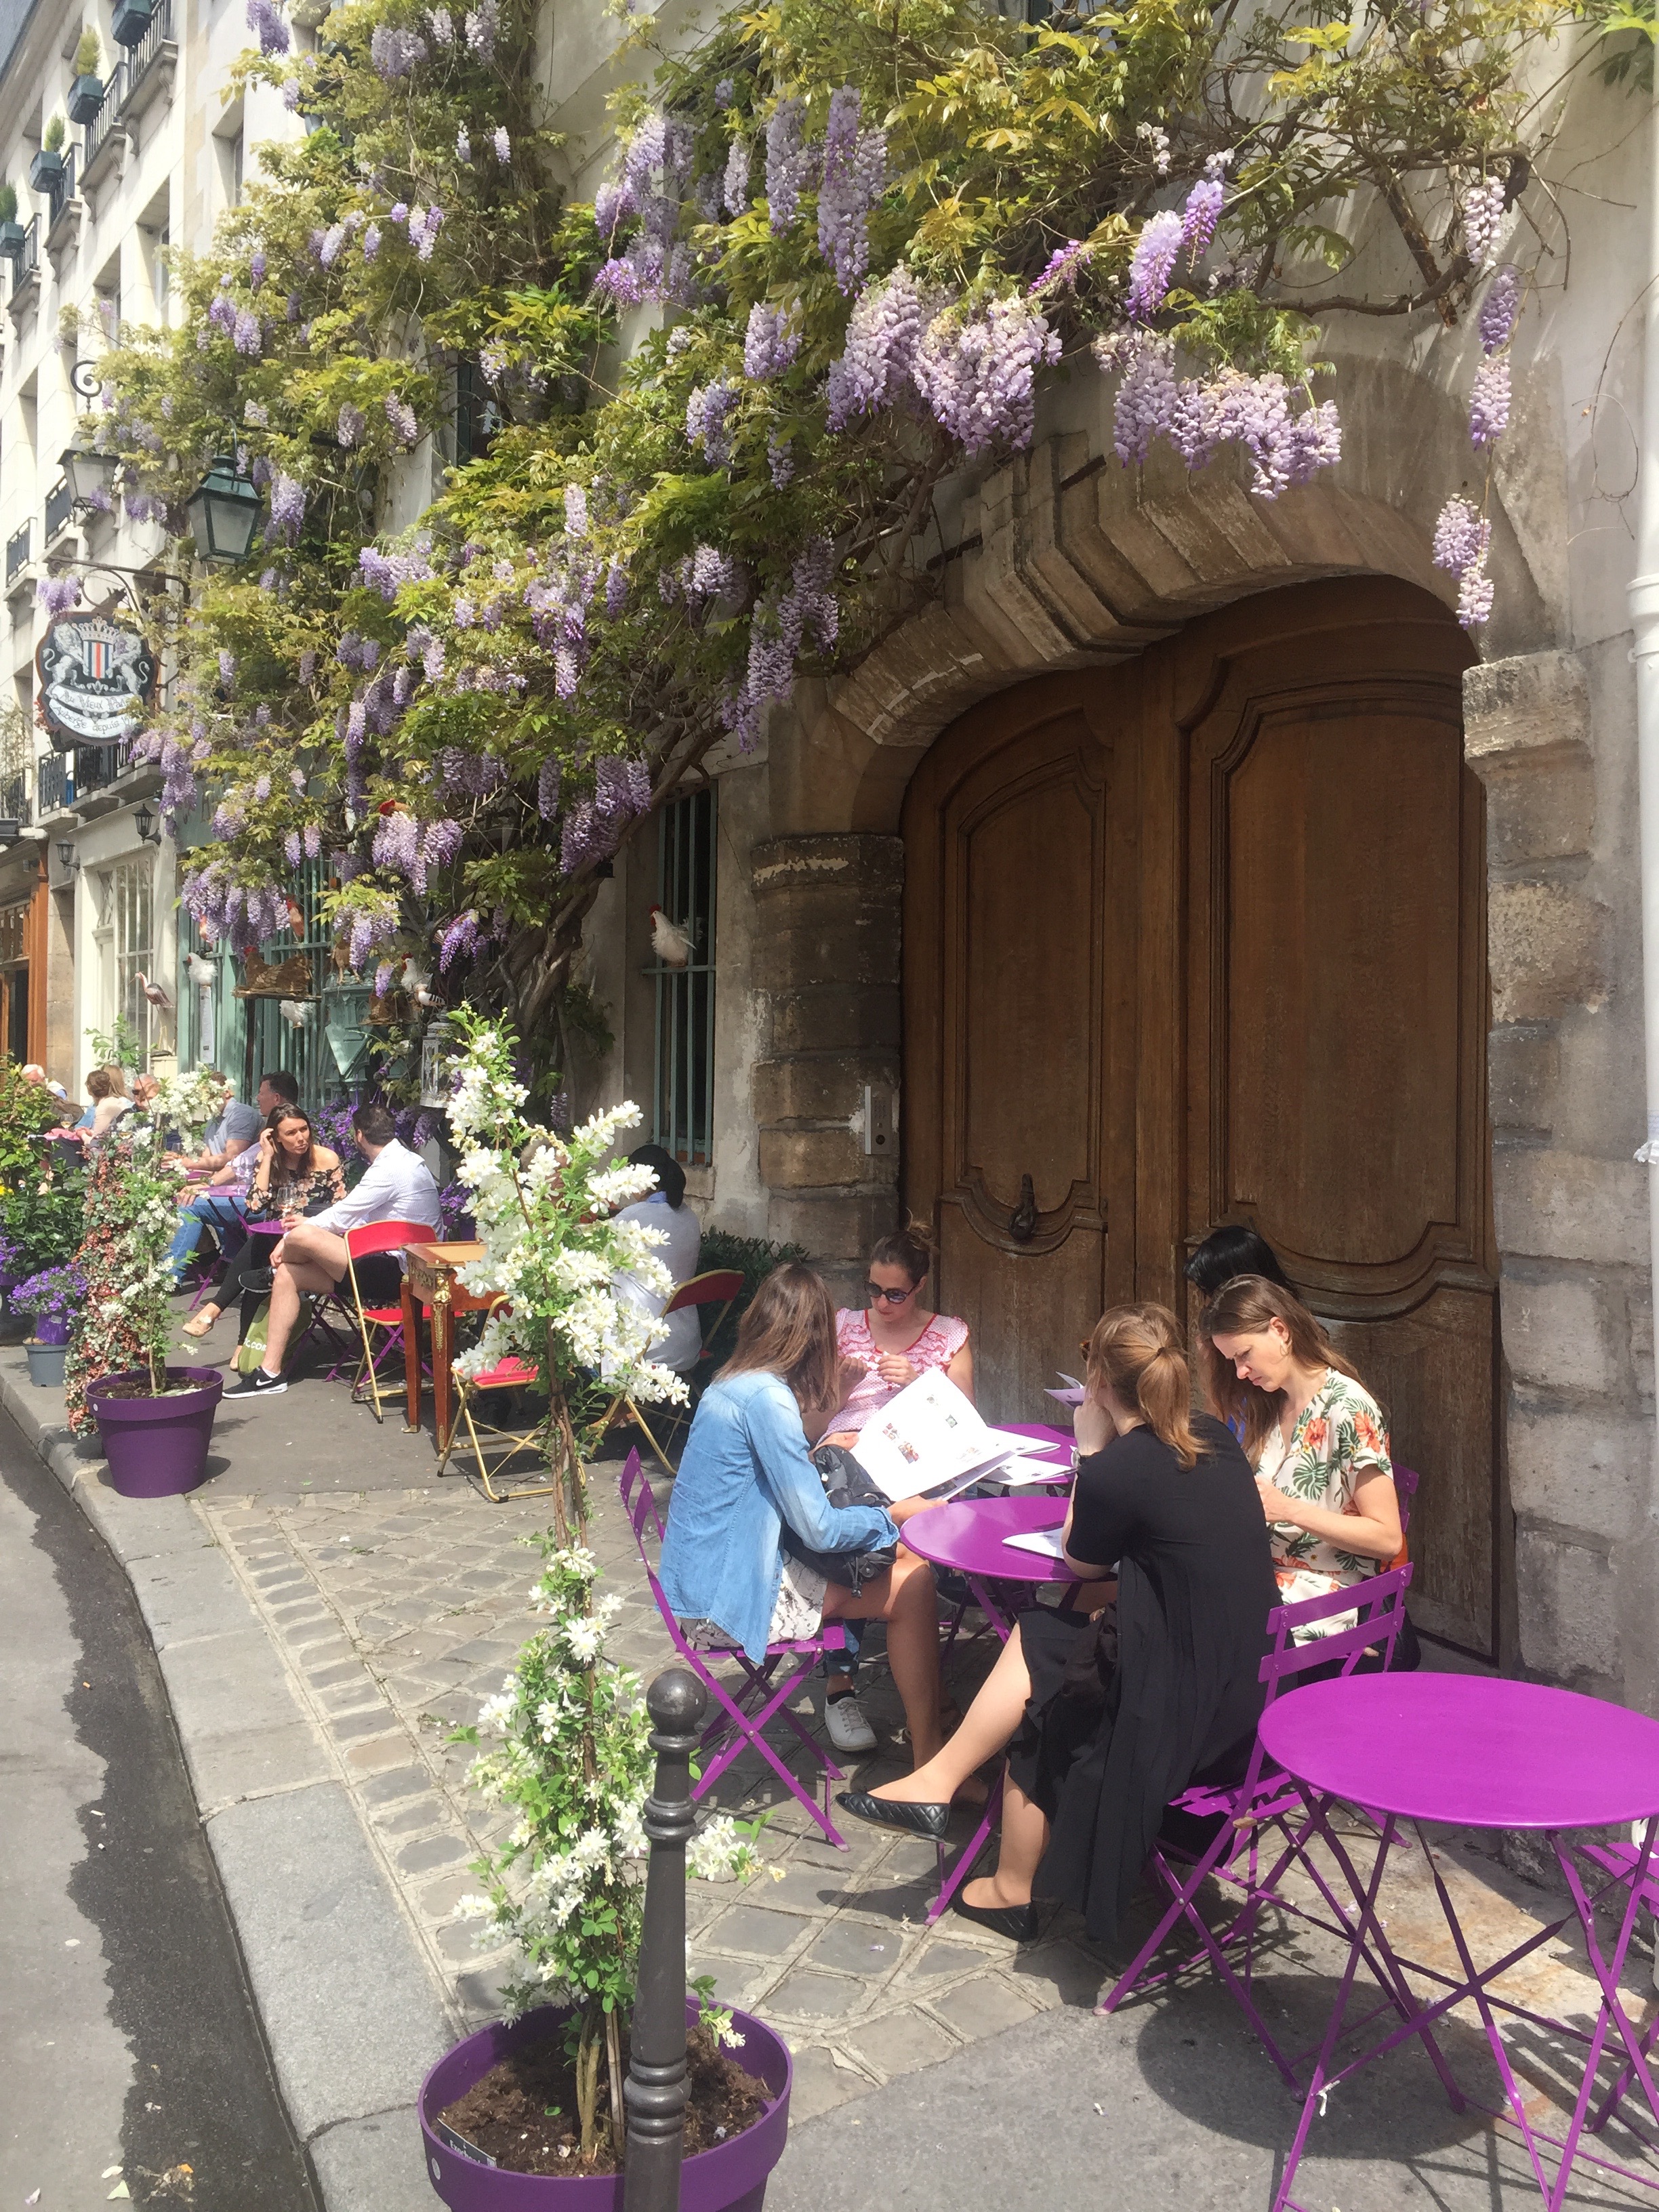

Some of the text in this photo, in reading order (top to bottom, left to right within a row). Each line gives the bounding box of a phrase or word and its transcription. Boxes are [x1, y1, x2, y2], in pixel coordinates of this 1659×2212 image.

[77, 694, 103, 710] Vieux
[53, 706, 87, 729] Auberge
[92, 720, 120, 734] depuis
